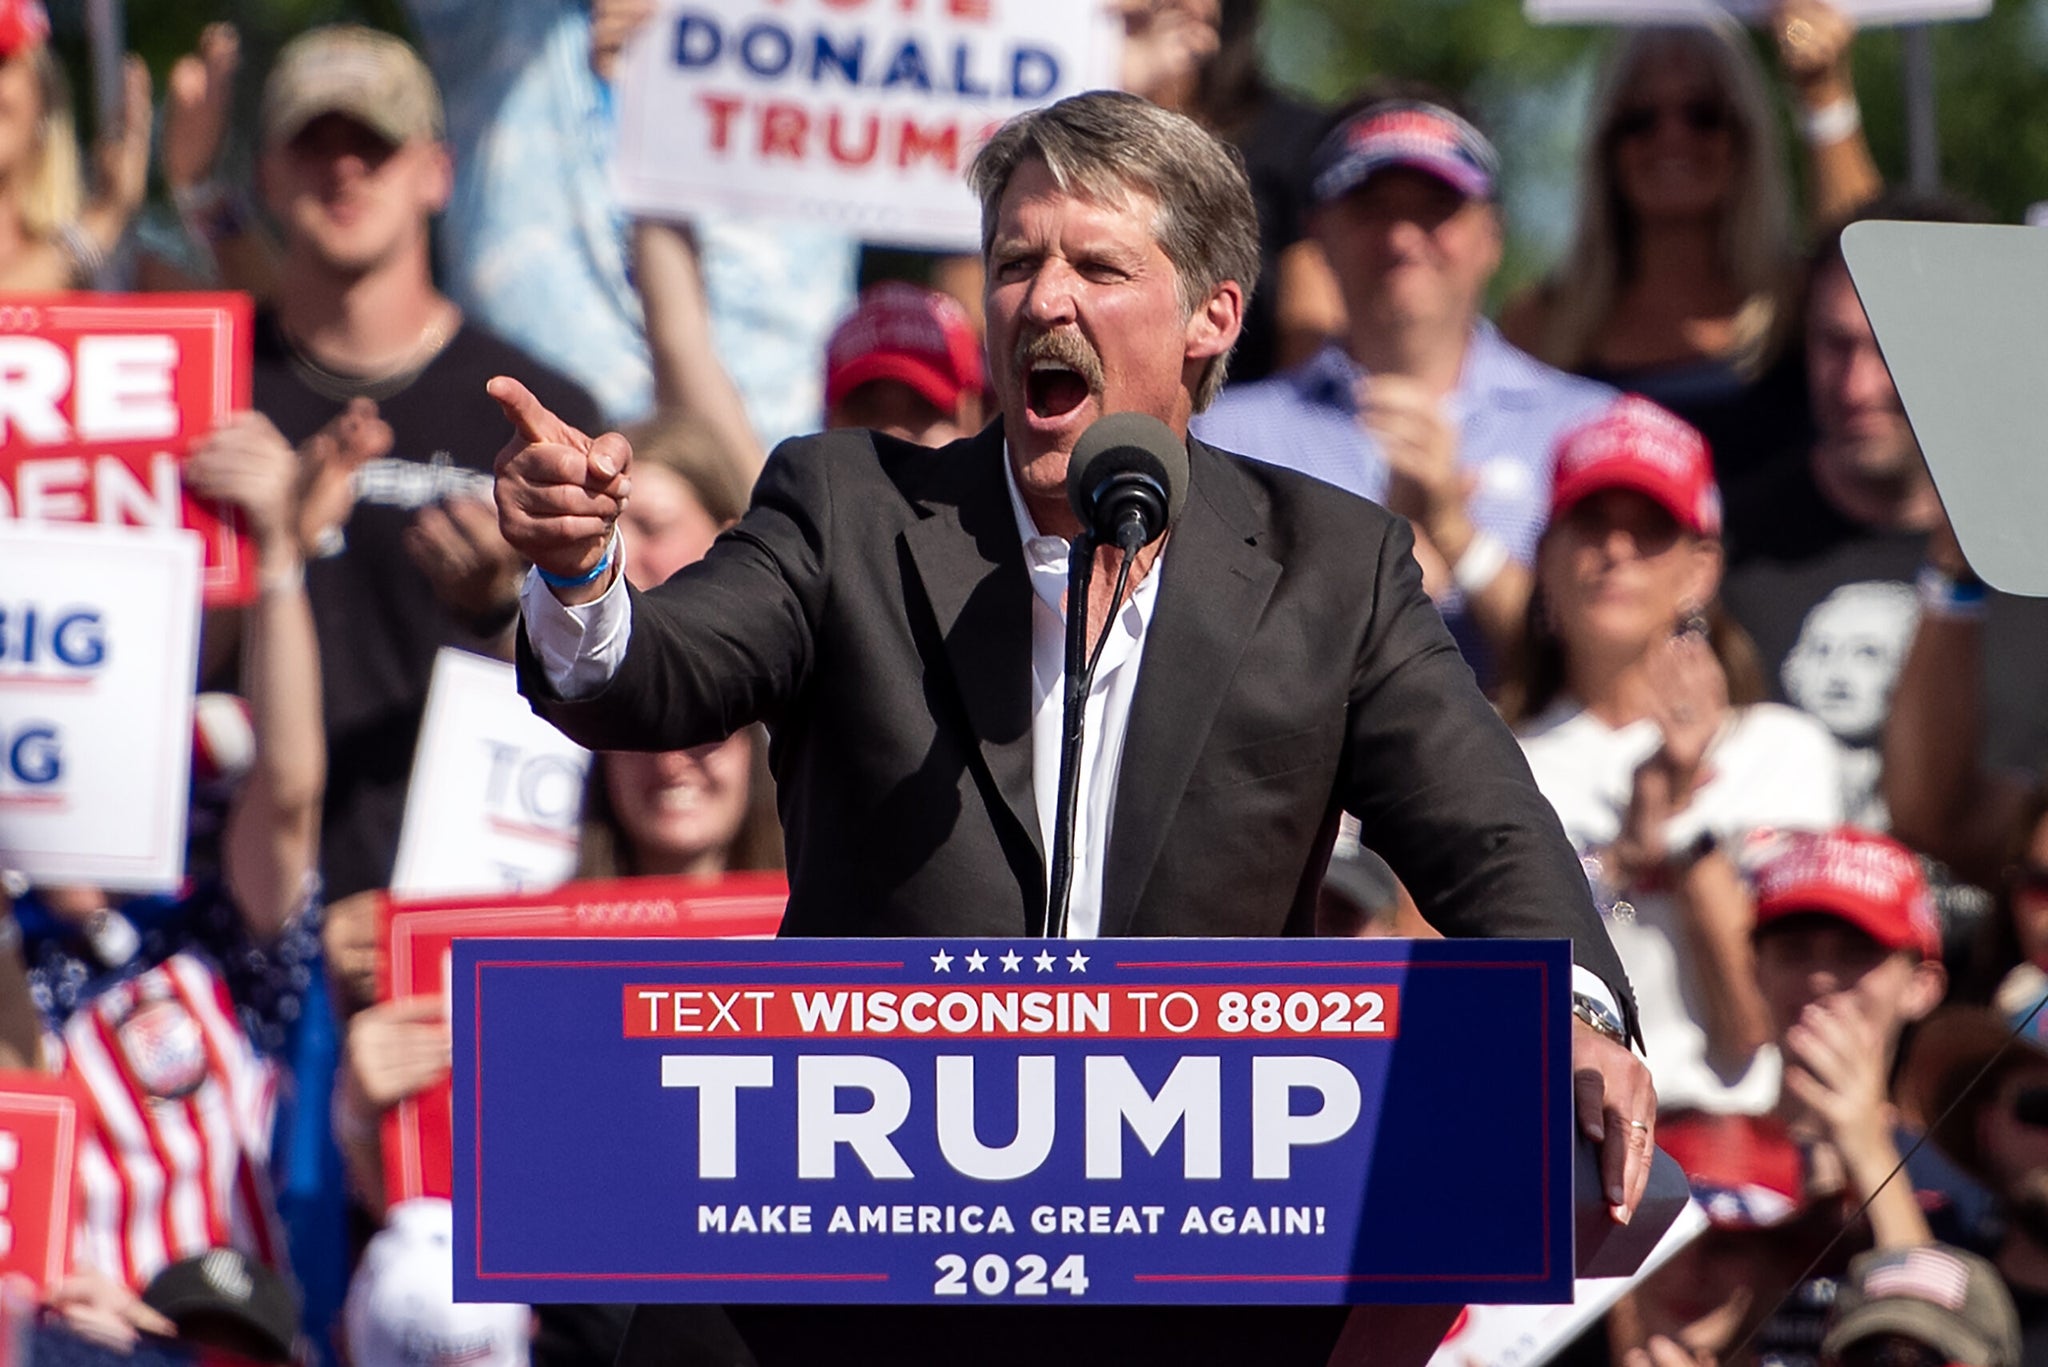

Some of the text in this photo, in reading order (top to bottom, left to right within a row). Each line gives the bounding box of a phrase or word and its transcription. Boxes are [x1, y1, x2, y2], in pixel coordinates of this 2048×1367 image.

[673, 13, 1061, 99] DONALD
[698, 93, 1002, 172] TRUM
[0, 452, 182, 528] EN
[0, 608, 106, 668] IG
[638, 991, 1385, 1033] TEXT WISCONSIN TO 88022
[661, 1055, 1362, 1181] TRUMP
[698, 1205, 1326, 1235] MAKE AMERICA GREAT AGAIN!
[933, 1254, 1090, 1296] 2024
